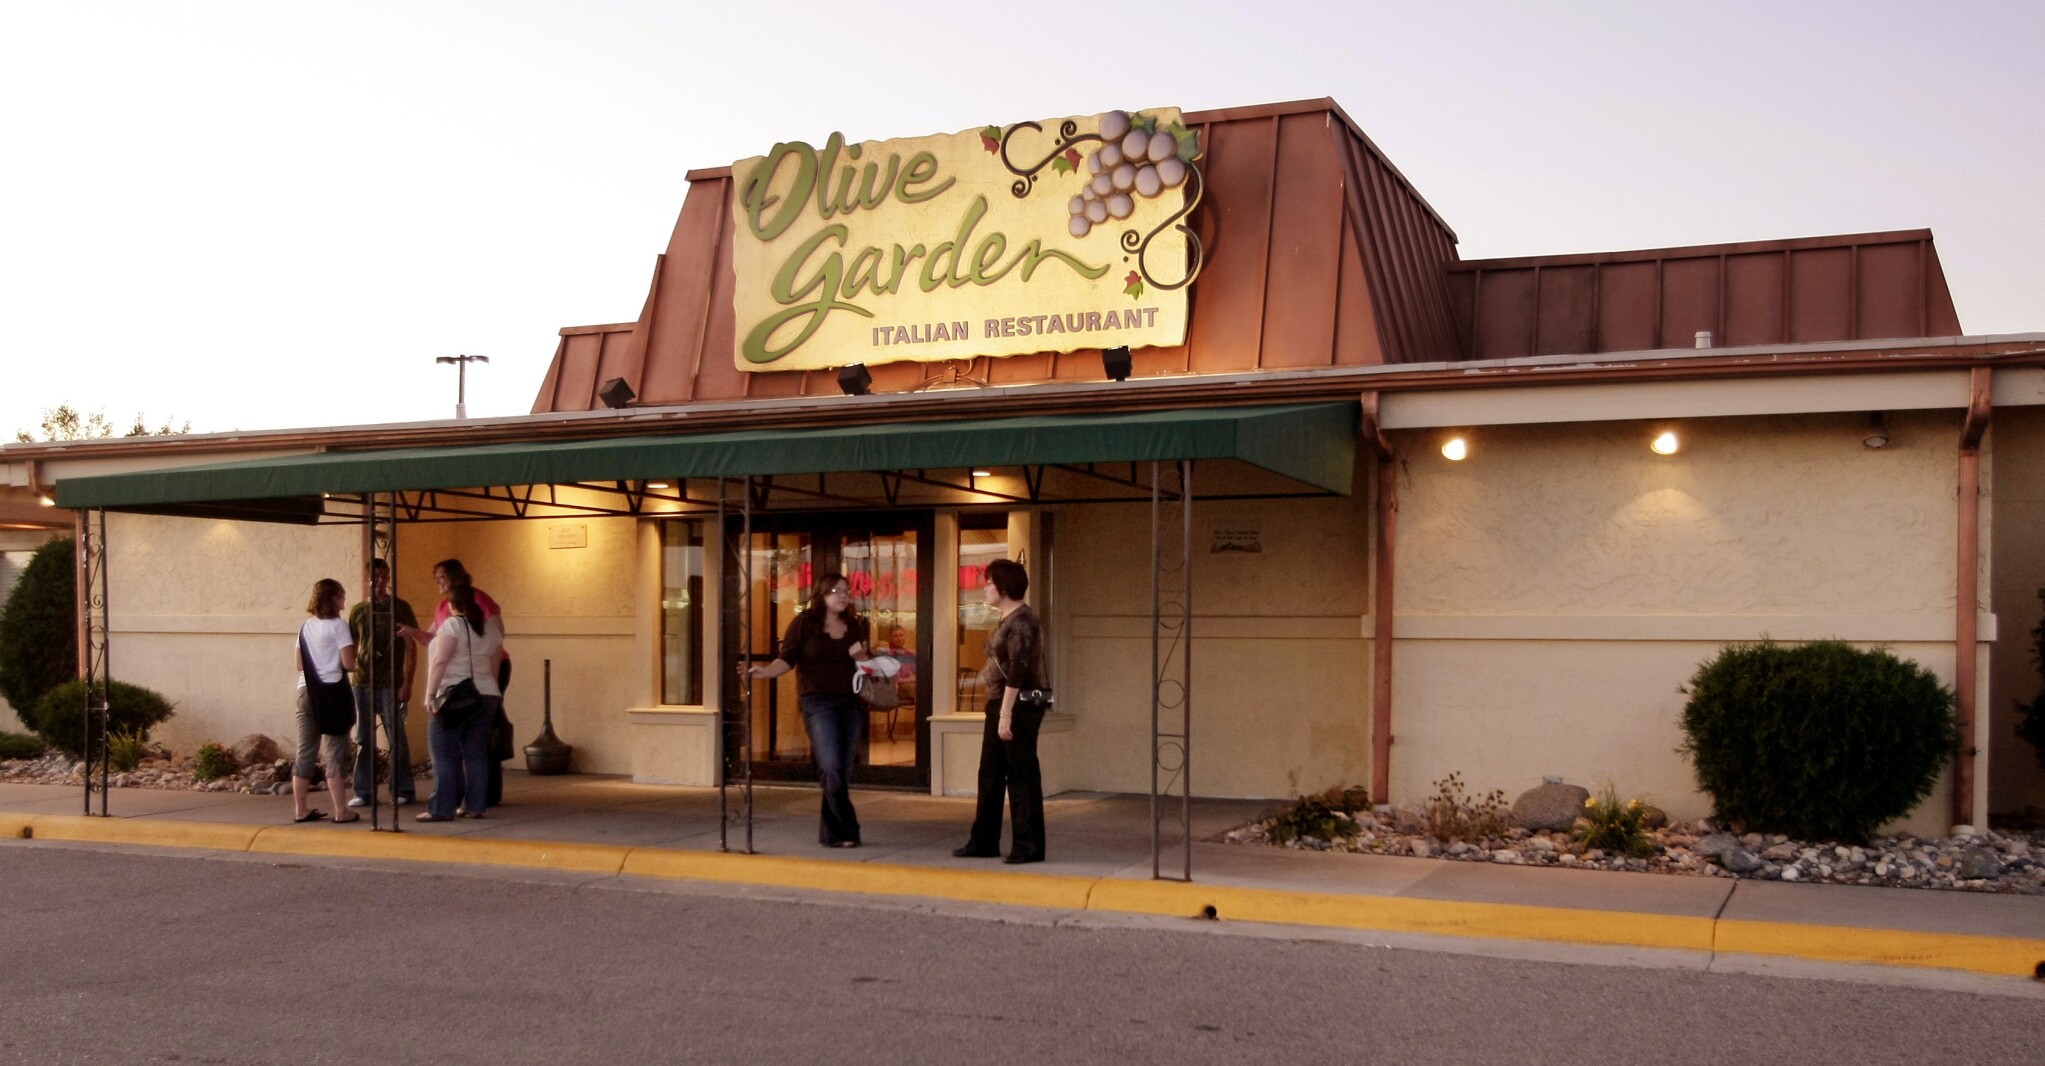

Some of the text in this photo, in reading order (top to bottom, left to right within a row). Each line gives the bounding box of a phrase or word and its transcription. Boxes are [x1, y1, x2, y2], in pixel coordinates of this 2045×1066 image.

[741, 131, 956, 241] Olive
[742, 195, 1111, 363] Garden
[872, 307, 1160, 346] ITALIAN RESTAURANT
